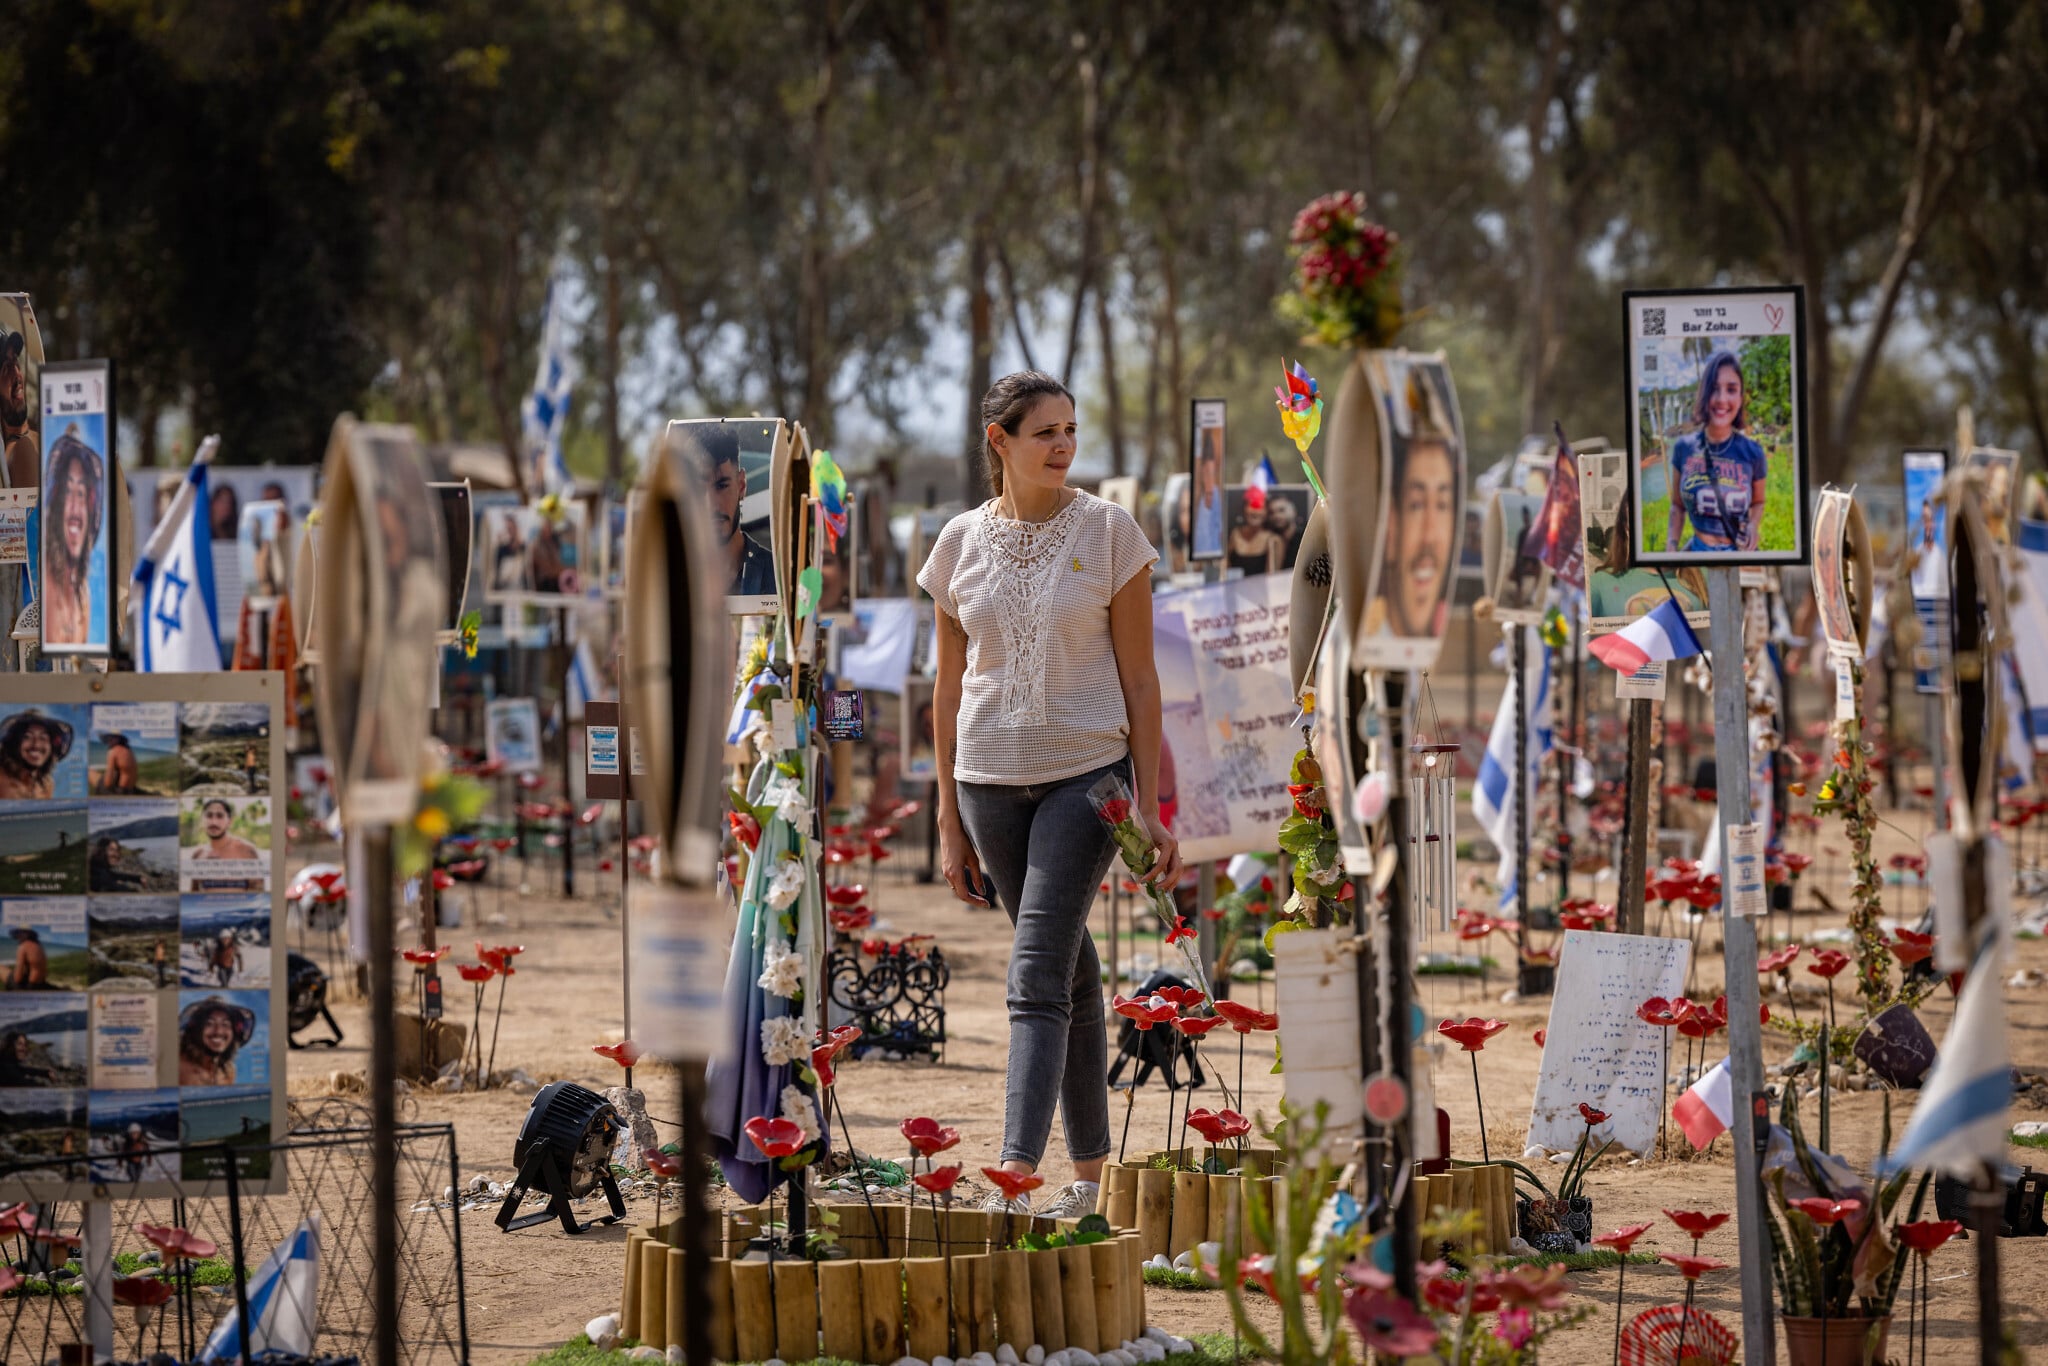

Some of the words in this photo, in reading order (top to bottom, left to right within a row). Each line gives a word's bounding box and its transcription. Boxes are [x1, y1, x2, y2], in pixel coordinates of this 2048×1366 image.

[1715, 308, 1726, 316] בר
[1682, 322, 1701, 332] Bar
[1705, 321, 1738, 331] Zohar
